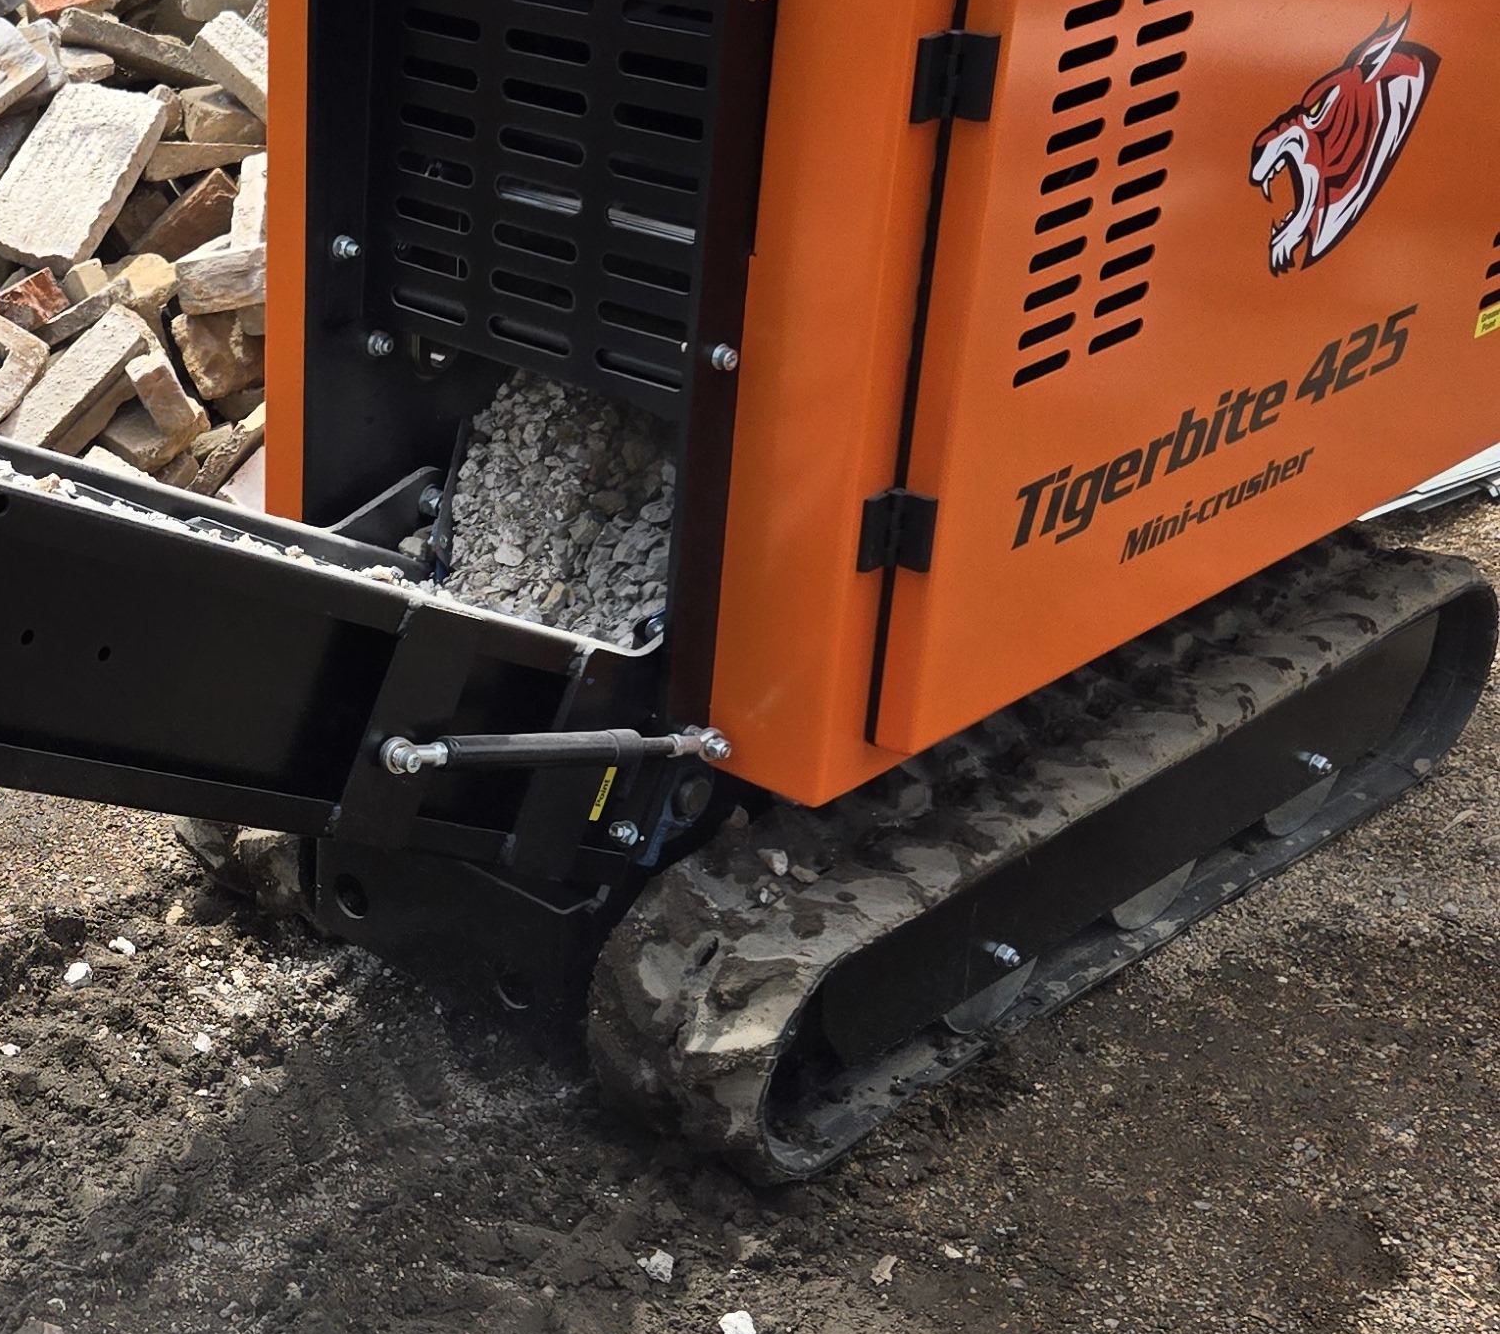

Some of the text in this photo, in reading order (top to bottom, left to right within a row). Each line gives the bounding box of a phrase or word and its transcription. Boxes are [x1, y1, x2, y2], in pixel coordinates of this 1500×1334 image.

[1010, 303, 1419, 551] Tigerbite 425
[1118, 447, 1316, 565] Mini-crusher
